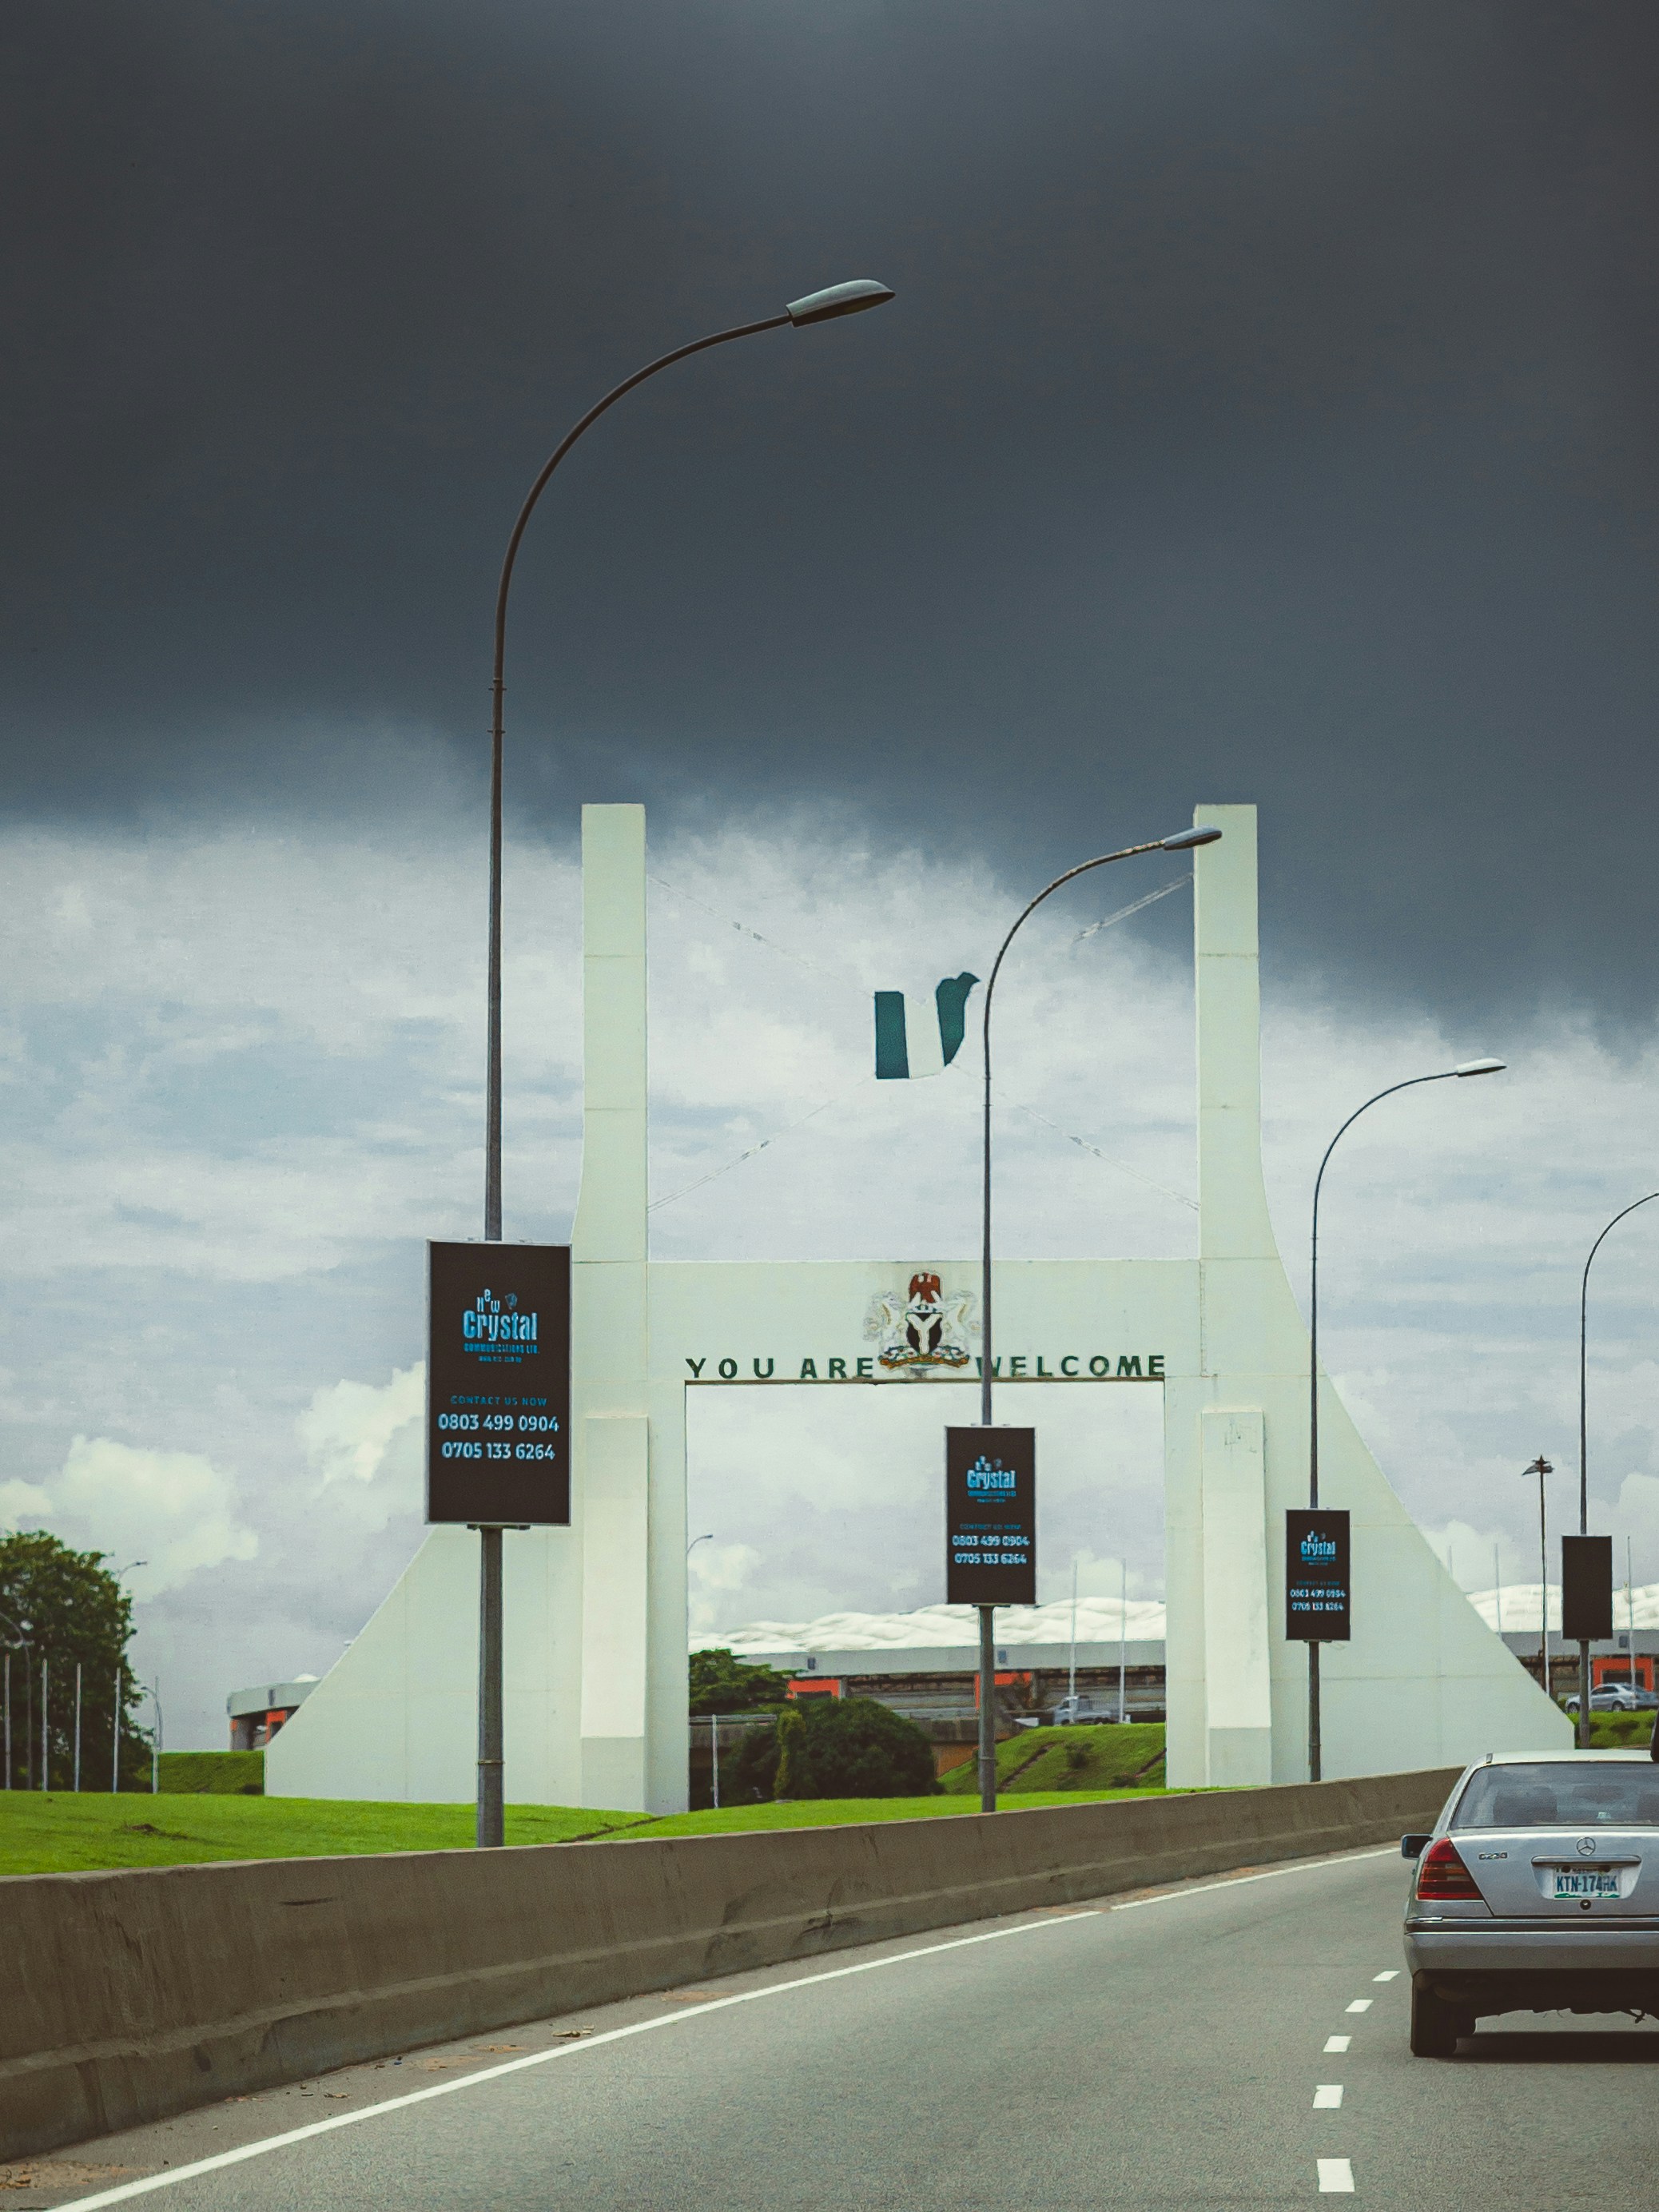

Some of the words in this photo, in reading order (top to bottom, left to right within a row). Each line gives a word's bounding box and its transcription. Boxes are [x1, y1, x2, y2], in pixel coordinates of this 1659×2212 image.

[463, 1310, 538, 1342] Crystal
[686, 1358, 774, 1379] YOU
[800, 1357, 873, 1379] ARE
[975, 1355, 1165, 1378] WELCOME
[451, 1395, 500, 1405] CONTACT
[522, 1398, 547, 1406] NOW
[438, 1413, 479, 1430] 0803
[482, 1414, 515, 1431] 499
[518, 1414, 559, 1432] 0904
[441, 1441, 483, 1459] 0705
[486, 1442, 511, 1459] 133
[515, 1442, 555, 1461] 6264
[966, 1470, 1016, 1490] Crystal
[980, 1535, 1001, 1546] 499
[1300, 1541, 1336, 1556] Crystal
[954, 1553, 981, 1565] 0705
[982, 1553, 1000, 1565] 133
